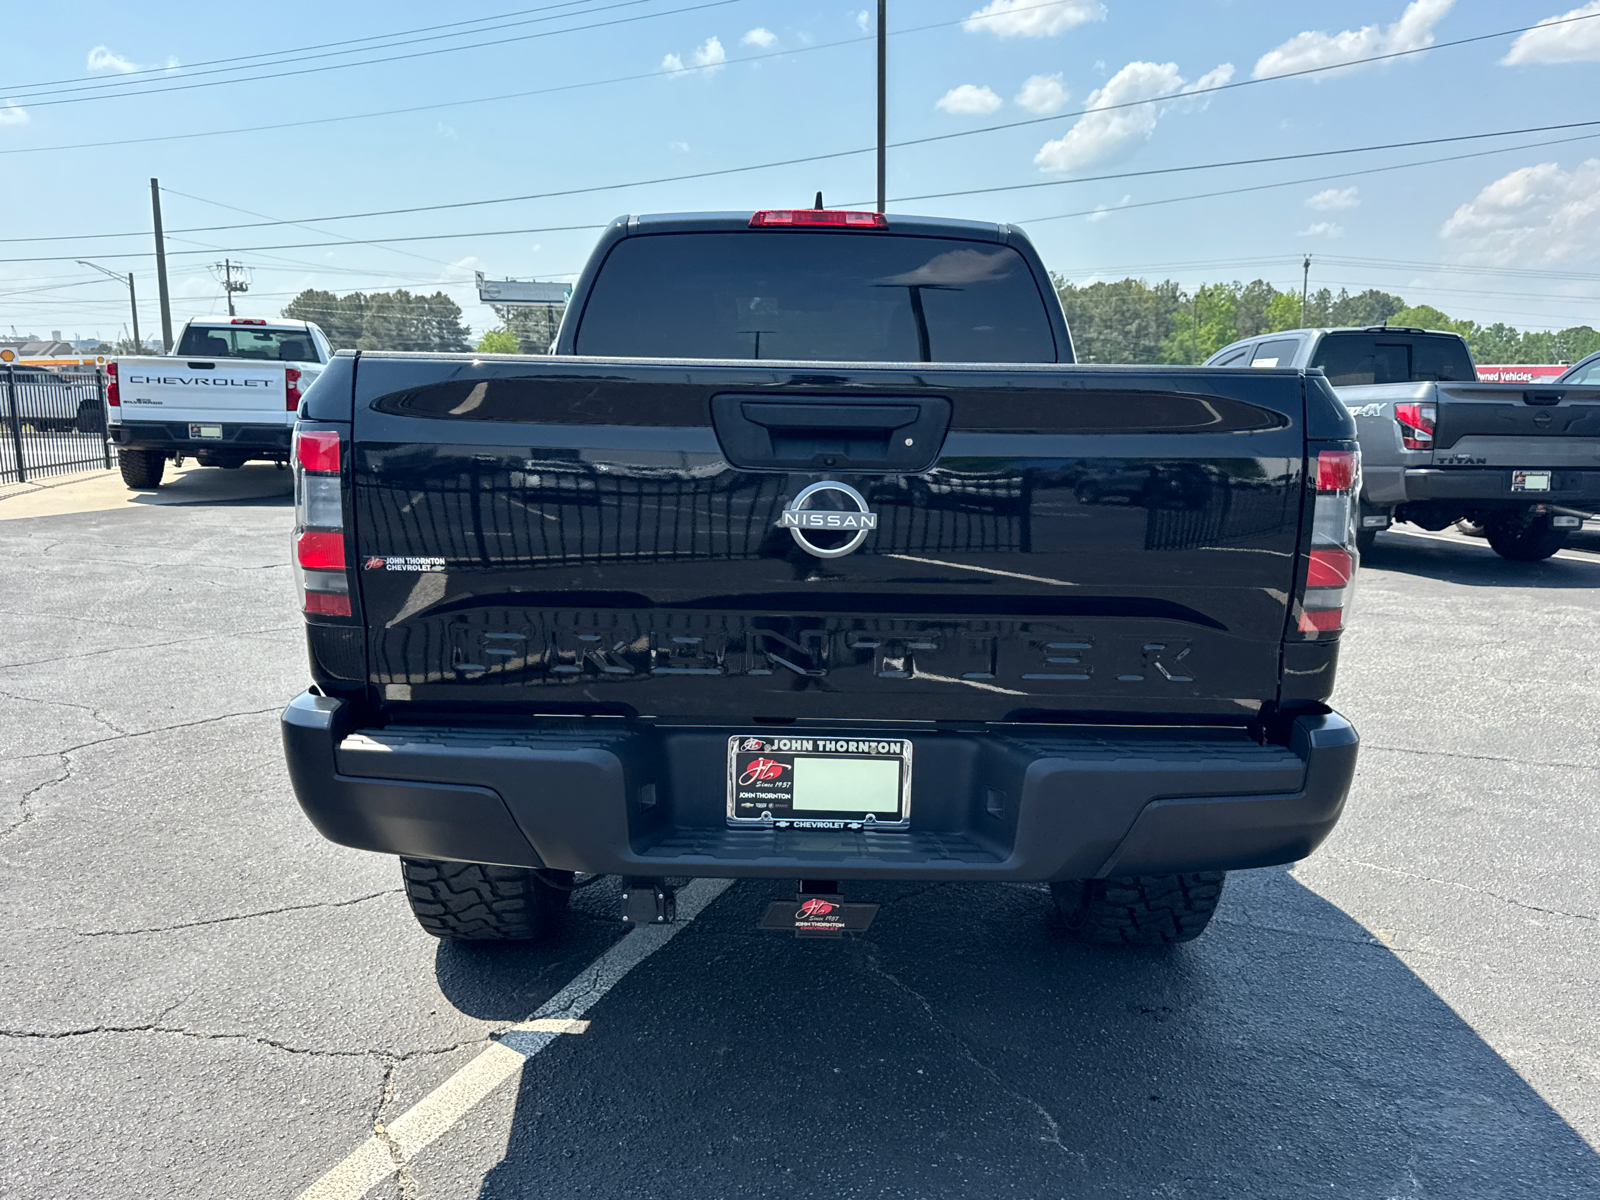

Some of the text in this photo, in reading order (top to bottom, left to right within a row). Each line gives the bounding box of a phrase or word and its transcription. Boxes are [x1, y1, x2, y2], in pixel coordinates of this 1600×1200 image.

[1500, 371, 1532, 381] Vehicles
[130, 376, 274, 387] CHEVROLET
[1437, 457, 1487, 465] TITAN
[784, 513, 875, 527] NISSAN
[406, 557, 445, 565] THORNTON
[772, 739, 901, 754] JOHN THORNTON
[793, 821, 844, 829] CHEVROLET
